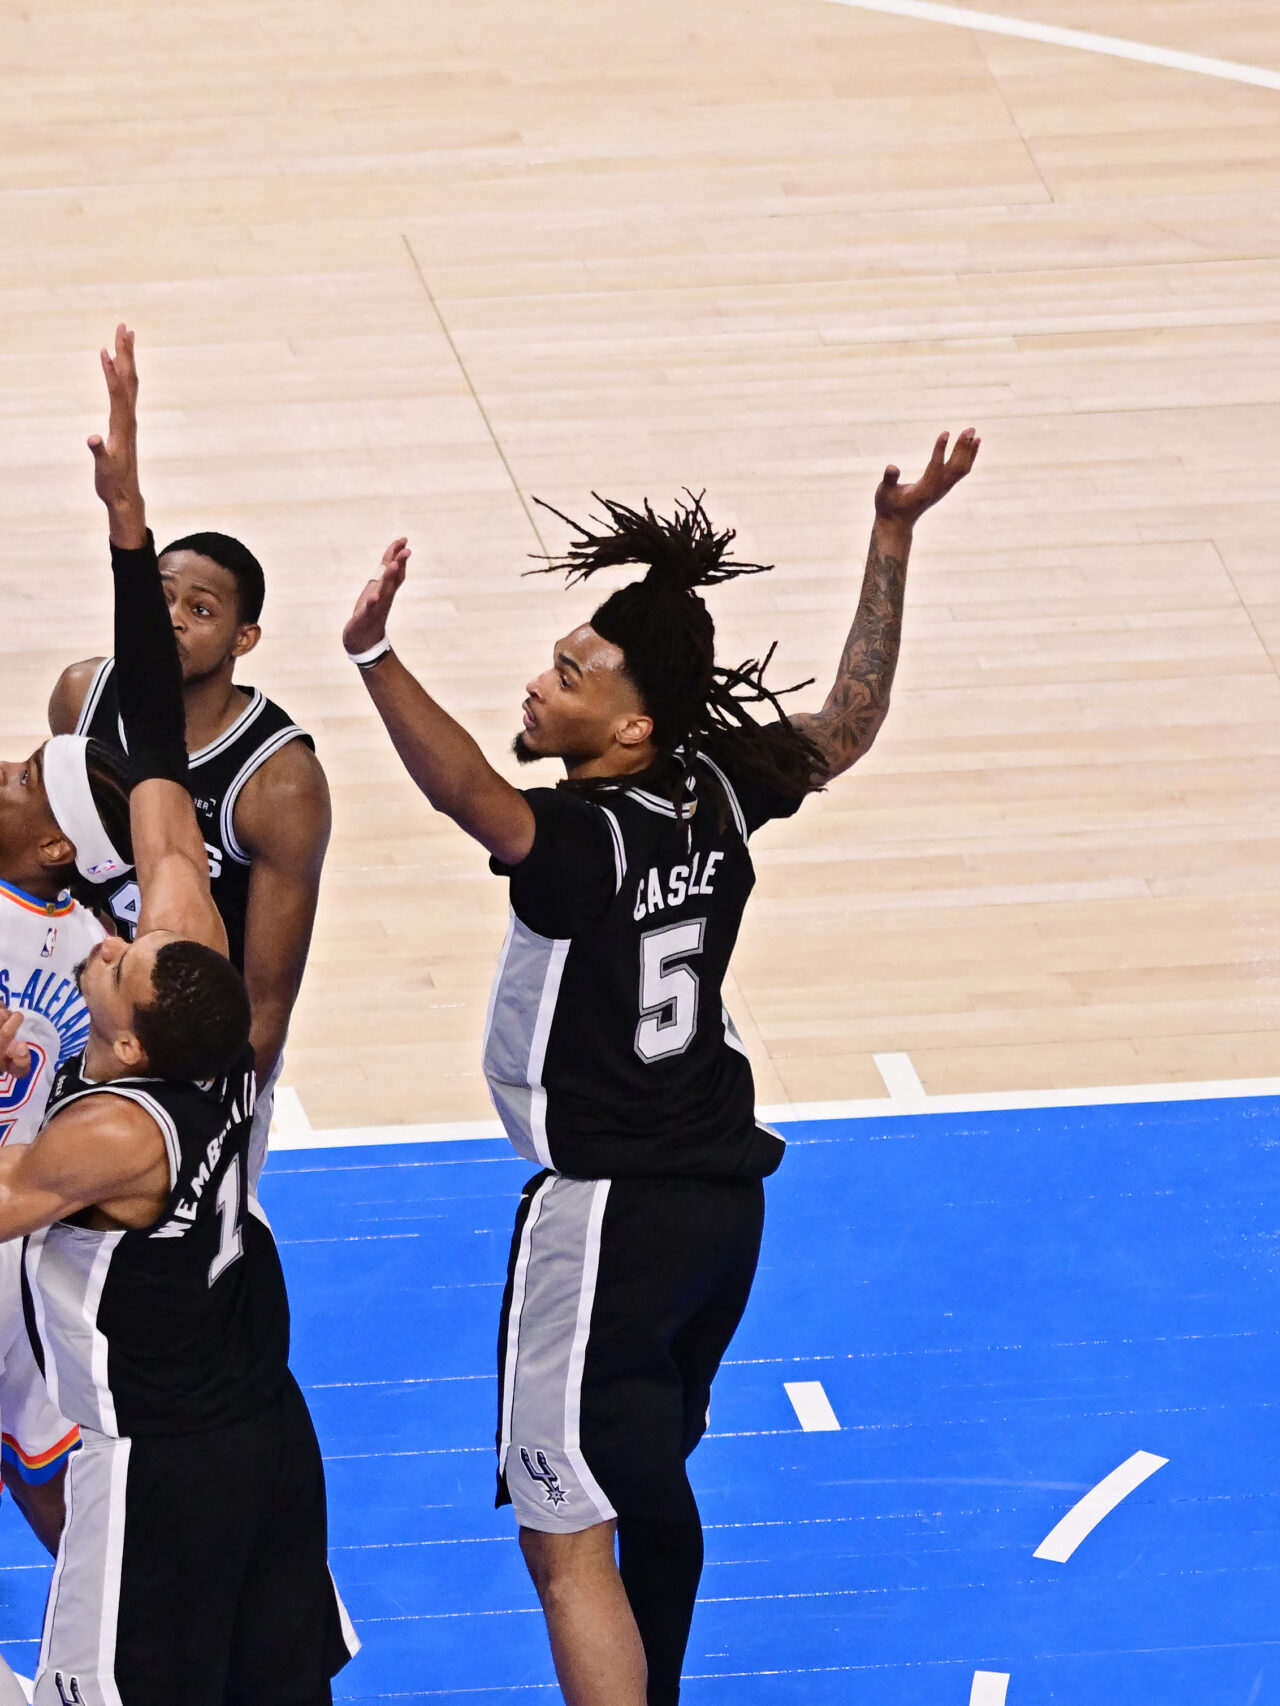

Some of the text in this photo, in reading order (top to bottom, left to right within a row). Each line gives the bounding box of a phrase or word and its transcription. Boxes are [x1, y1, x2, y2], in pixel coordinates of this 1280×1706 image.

[633, 851, 725, 921] CASLE
[634, 917, 707, 1065] 5
[208, 1152, 244, 1289] 1
